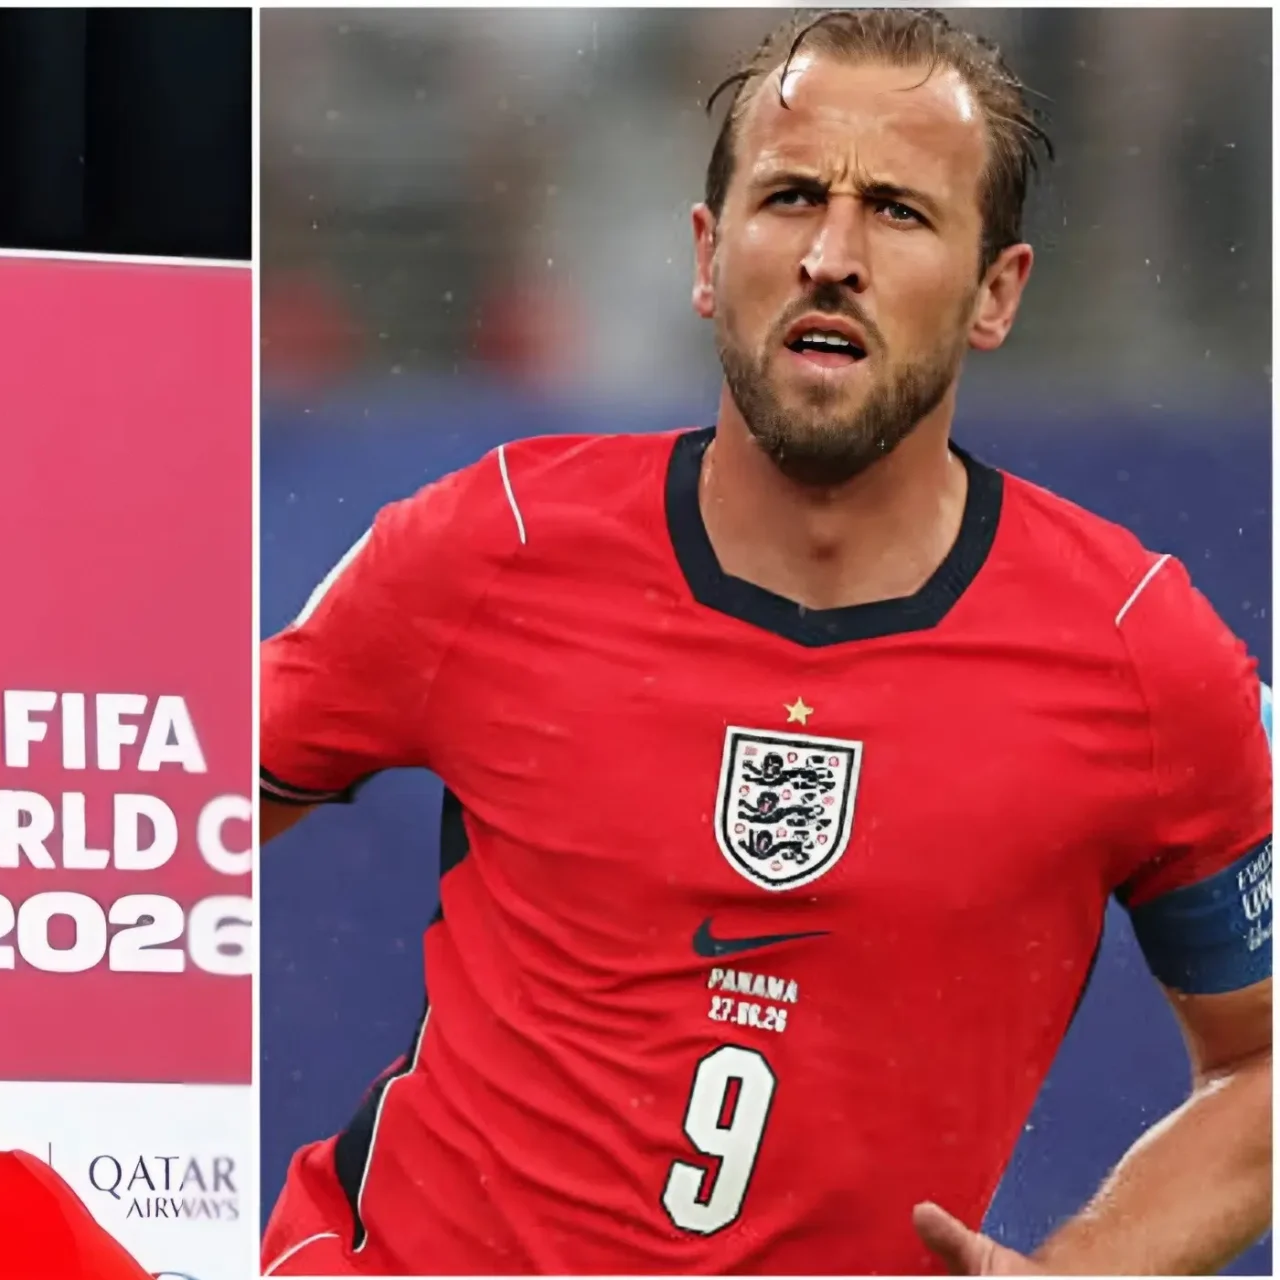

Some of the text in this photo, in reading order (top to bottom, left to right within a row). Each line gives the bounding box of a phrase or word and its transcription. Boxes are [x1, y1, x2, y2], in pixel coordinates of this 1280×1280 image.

[4, 690, 208, 773] FIFA
[662, 1042, 778, 1237] 9
[88, 1154, 237, 1201] QATAR
[125, 1196, 240, 1221] AIRWAYS
